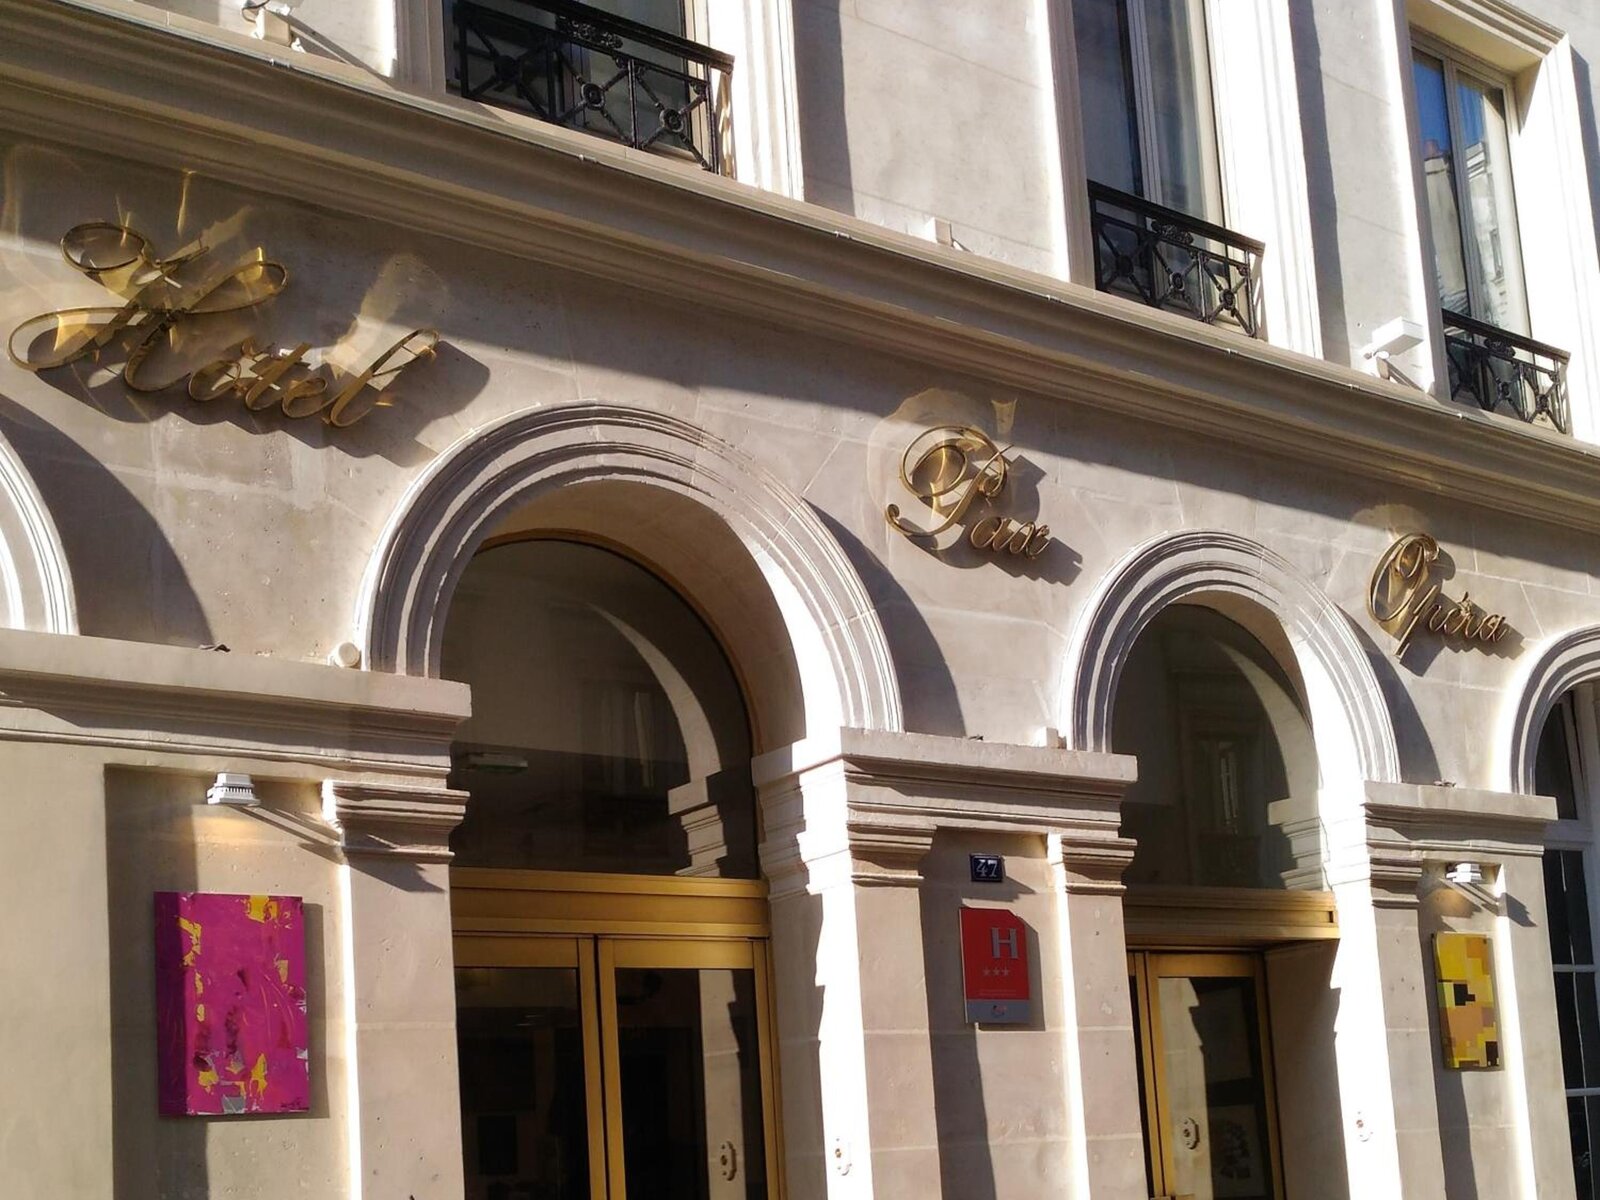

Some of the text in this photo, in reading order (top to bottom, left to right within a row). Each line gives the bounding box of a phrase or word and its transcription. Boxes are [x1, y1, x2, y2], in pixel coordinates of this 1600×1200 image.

[8, 221, 440, 427] Hôtel
[1367, 532, 1512, 659] Opéra
[976, 858, 998, 878] 47
[991, 927, 1018, 959] H
